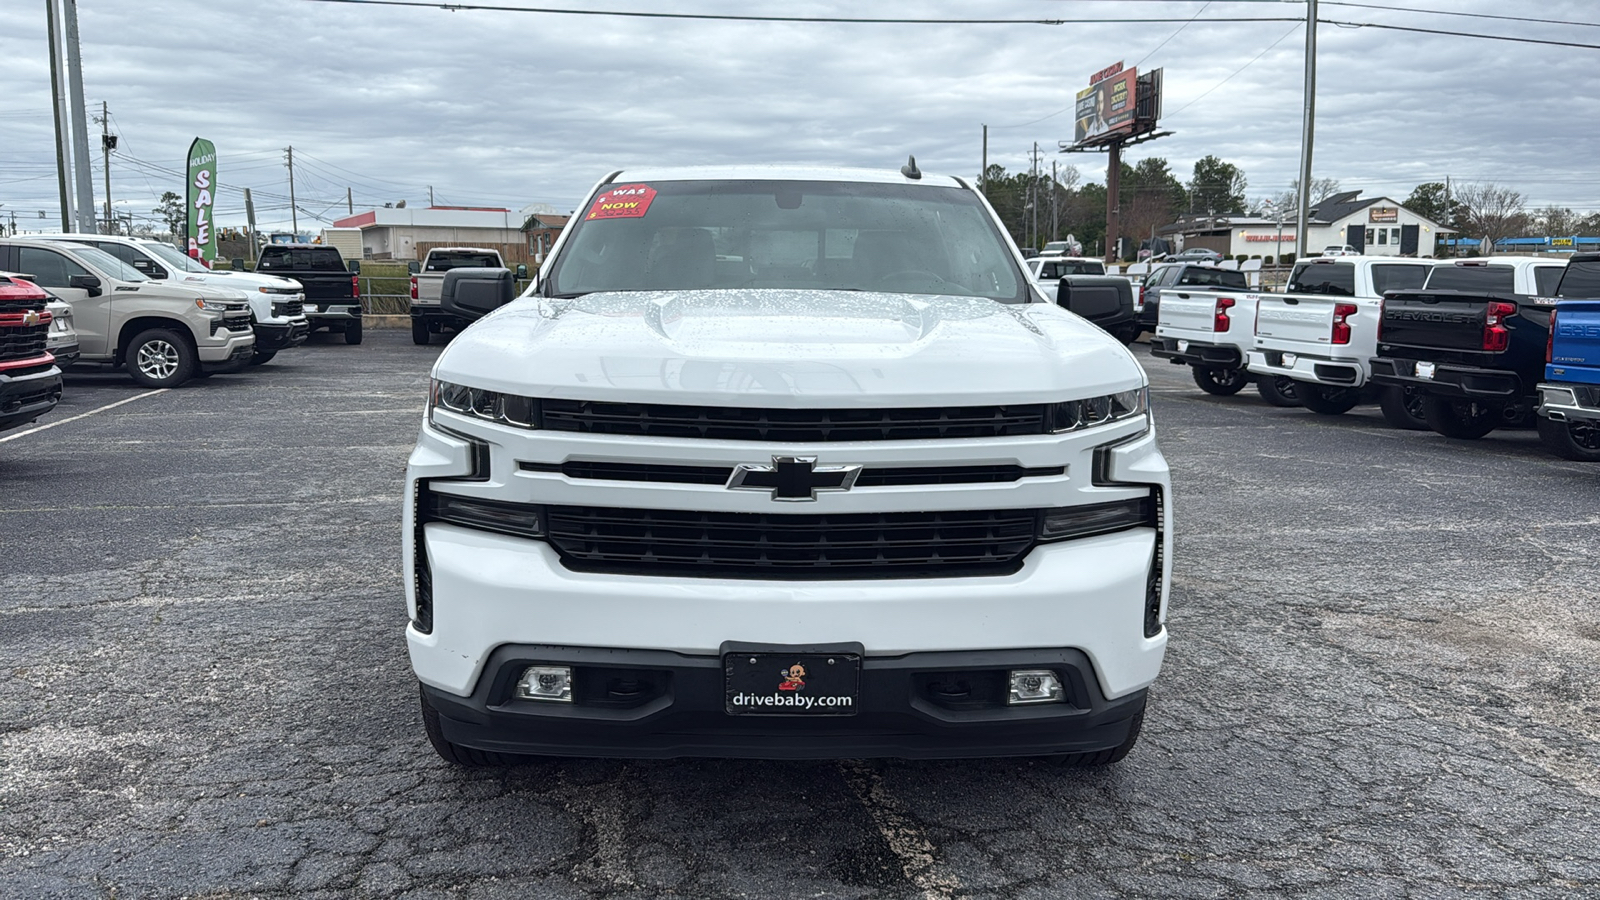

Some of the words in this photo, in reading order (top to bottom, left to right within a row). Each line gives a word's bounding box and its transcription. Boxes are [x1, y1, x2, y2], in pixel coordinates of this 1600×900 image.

[190, 154, 215, 168] HOLIDAY
[194, 169, 211, 245] SALE
[601, 202, 639, 210] NOW
[1259, 310, 1326, 322] CHEVROLET
[1385, 310, 1477, 324] CHEVROLET
[733, 692, 852, 709] drivebaby.com
